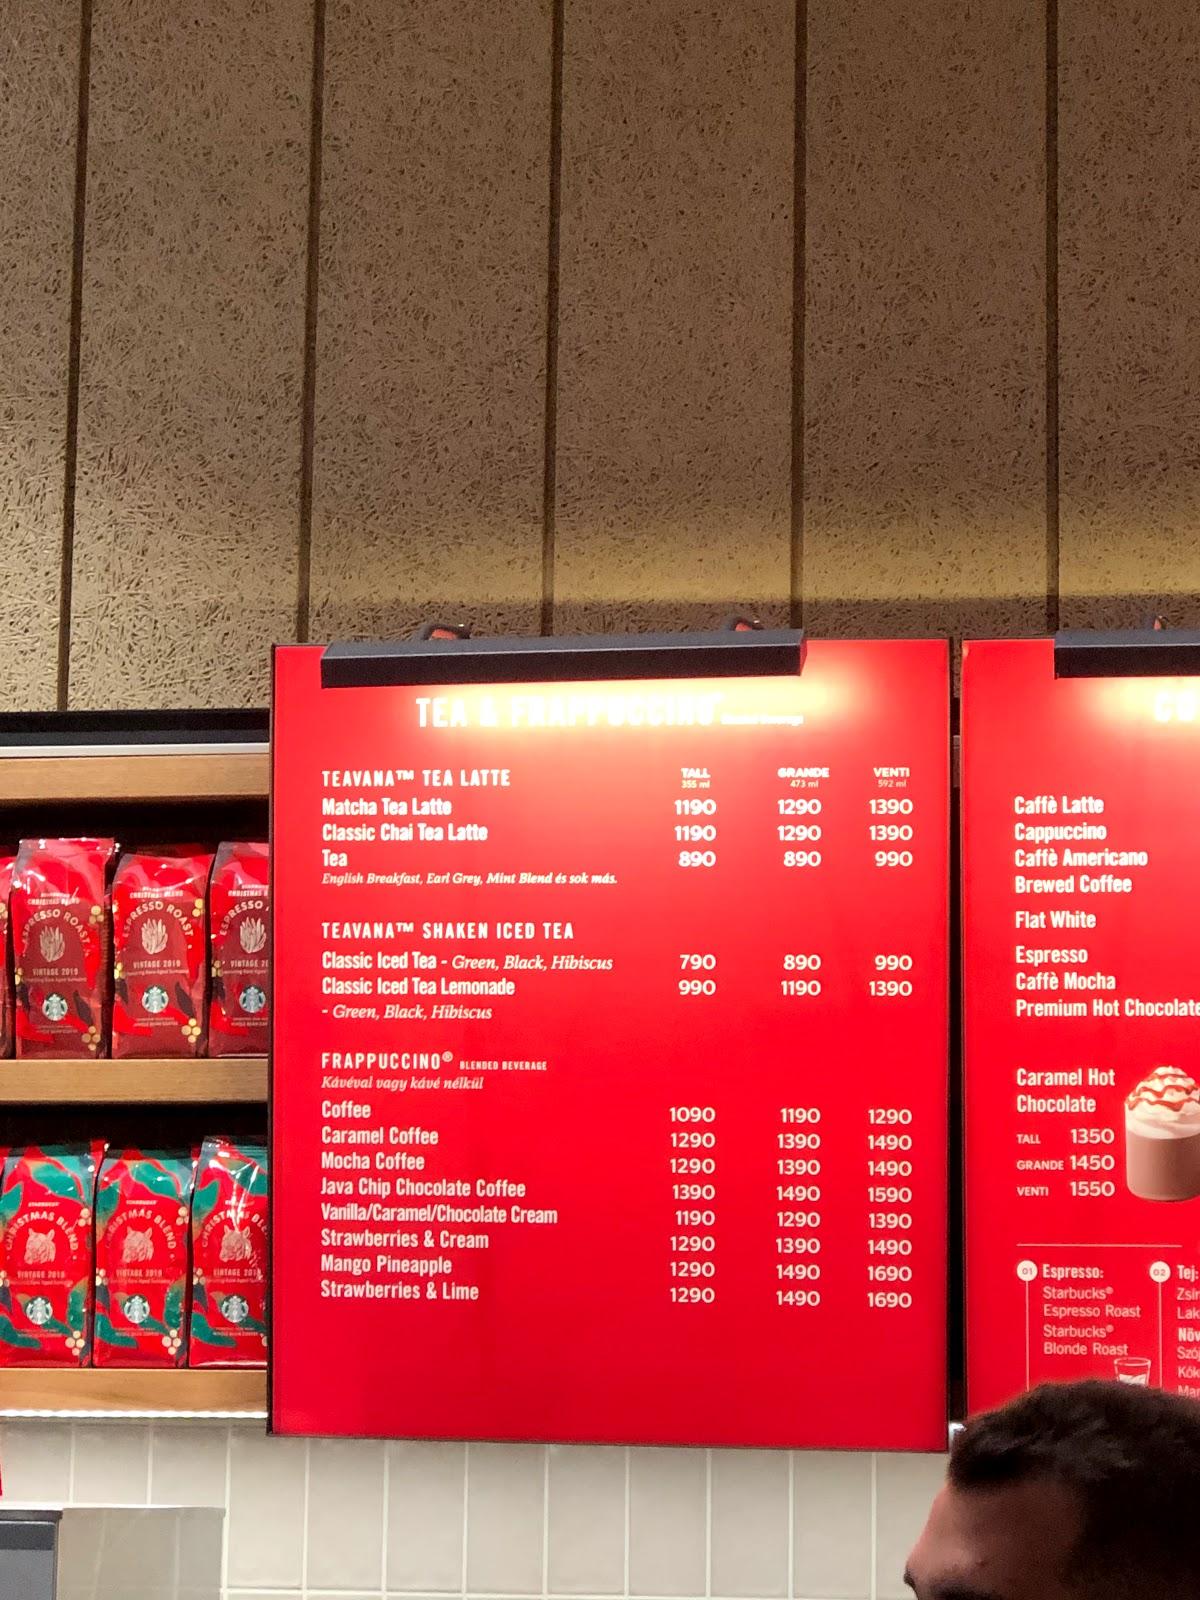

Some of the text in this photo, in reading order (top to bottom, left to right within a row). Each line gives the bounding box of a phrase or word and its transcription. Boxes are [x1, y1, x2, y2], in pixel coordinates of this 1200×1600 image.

[416, 697, 468, 728] TEA
[422, 769, 453, 786] TEA
[460, 769, 510, 786] LATTE
[681, 768, 710, 778] TALL
[778, 768, 829, 778] GRANDE
[874, 768, 909, 777] VENTI
[790, 779, 806, 788] 473
[878, 779, 894, 787] 592
[323, 798, 452, 815] Matcha Tea Latte
[675, 799, 716, 815] 1190
[778, 799, 821, 815] 1290
[869, 799, 913, 814] 1390
[1015, 796, 1104, 814] Caffè Latte
[323, 823, 488, 841] Classic Chai Tea Latte
[675, 825, 716, 841] 1190
[777, 825, 821, 841] 1290
[869, 825, 913, 840] 1390
[1015, 822, 1107, 844] Cappuccino
[322, 849, 347, 866] Tea
[679, 851, 716, 867] 890
[784, 851, 821, 866] 890
[875, 851, 912, 866] 990
[1015, 848, 1148, 867] Caffè Americano
[323, 873, 363, 886] English
[367, 873, 422, 886] Breakfast,
[427, 872, 450, 884] Earl
[452, 873, 483, 886] Grey,
[486, 873, 516, 884] Mint
[555, 873, 567, 884] és
[569, 872, 588, 884] sok
[1015, 875, 1132, 893] Brewed Coffee
[166, 904, 194, 936] ROAST
[219, 900, 263, 936] ESPRESSO
[1016, 911, 1096, 928] Flat White
[423, 922, 488, 939] SHAKEN
[497, 923, 534, 939] ICED
[543, 923, 573, 939] TEA
[322, 951, 612, 971] Classic Iced Tea Green, Black, Hibiscus
[680, 954, 716, 970] 790
[784, 955, 821, 970] 890
[875, 955, 912, 970] 990
[1016, 946, 1088, 966] Espresso
[322, 977, 515, 995] Classic Iced Tea Lemonade
[679, 980, 716, 995] 990
[781, 980, 821, 995] 1190
[869, 981, 912, 996] 1390
[1016, 972, 1115, 990] Caffè Mocha
[333, 1004, 492, 1020] Green, Black, Hibiscus
[1016, 999, 1087, 1016] Premium
[1093, 999, 1119, 1016] Hot
[460, 1061, 546, 1070] BLENDED BEVERAGE
[321, 1076, 373, 1088] Kávéval
[376, 1079, 407, 1091] vagy
[410, 1076, 440, 1089] kávé
[1017, 1068, 1115, 1086] Caramel Hot
[322, 1101, 371, 1118] Coffee
[1017, 1095, 1096, 1112] Chocolate
[670, 1107, 715, 1122] 1090
[781, 1108, 820, 1123] 1190
[869, 1109, 912, 1124] 1290
[322, 1126, 438, 1144] Caramel Coffee
[671, 1133, 715, 1148] 1290
[778, 1134, 820, 1149] 1390
[868, 1135, 912, 1150] 1490
[1017, 1134, 1040, 1144] TALL
[1071, 1128, 1114, 1144] 1350
[322, 1152, 424, 1170] Mocha Coffee
[670, 1158, 715, 1174] 1290
[778, 1160, 820, 1175] 1390
[868, 1161, 912, 1176] 1490
[1017, 1160, 1064, 1170] GRANDE
[1070, 1155, 1114, 1170] 1450
[321, 1177, 525, 1199] Java Chip Chocolate Coffee
[673, 1185, 715, 1200] 1390
[777, 1186, 820, 1201] 1490
[868, 1187, 912, 1202] 1590
[1017, 1187, 1048, 1196] VENTI
[1070, 1181, 1115, 1196] 1550
[321, 1203, 557, 1223] Vanilla/Caramel/Chocolate Cream
[676, 1210, 715, 1225] 1190
[777, 1212, 820, 1227] 1290
[869, 1213, 912, 1228] 1390
[154, 1214, 177, 1249] BLEND
[322, 1228, 488, 1248] Strawberries & Cream
[671, 1236, 715, 1251] 1290
[776, 1238, 820, 1253] 1390
[868, 1240, 912, 1255] 1490
[321, 1254, 452, 1277] Mango Pineapple
[671, 1262, 715, 1277] 1290
[777, 1264, 820, 1279] 1490
[1043, 1264, 1103, 1280] Espresso:
[868, 1266, 912, 1281] 1690
[1177, 1265, 1198, 1282] Tej:
[321, 1280, 478, 1300] Strawberries & Lime
[670, 1288, 715, 1303] 1290
[777, 1291, 820, 1306] 1490
[868, 1292, 912, 1308] 1690
[1044, 1304, 1140, 1319] Espresso Roast
[1044, 1342, 1129, 1357] Blonde Roast
